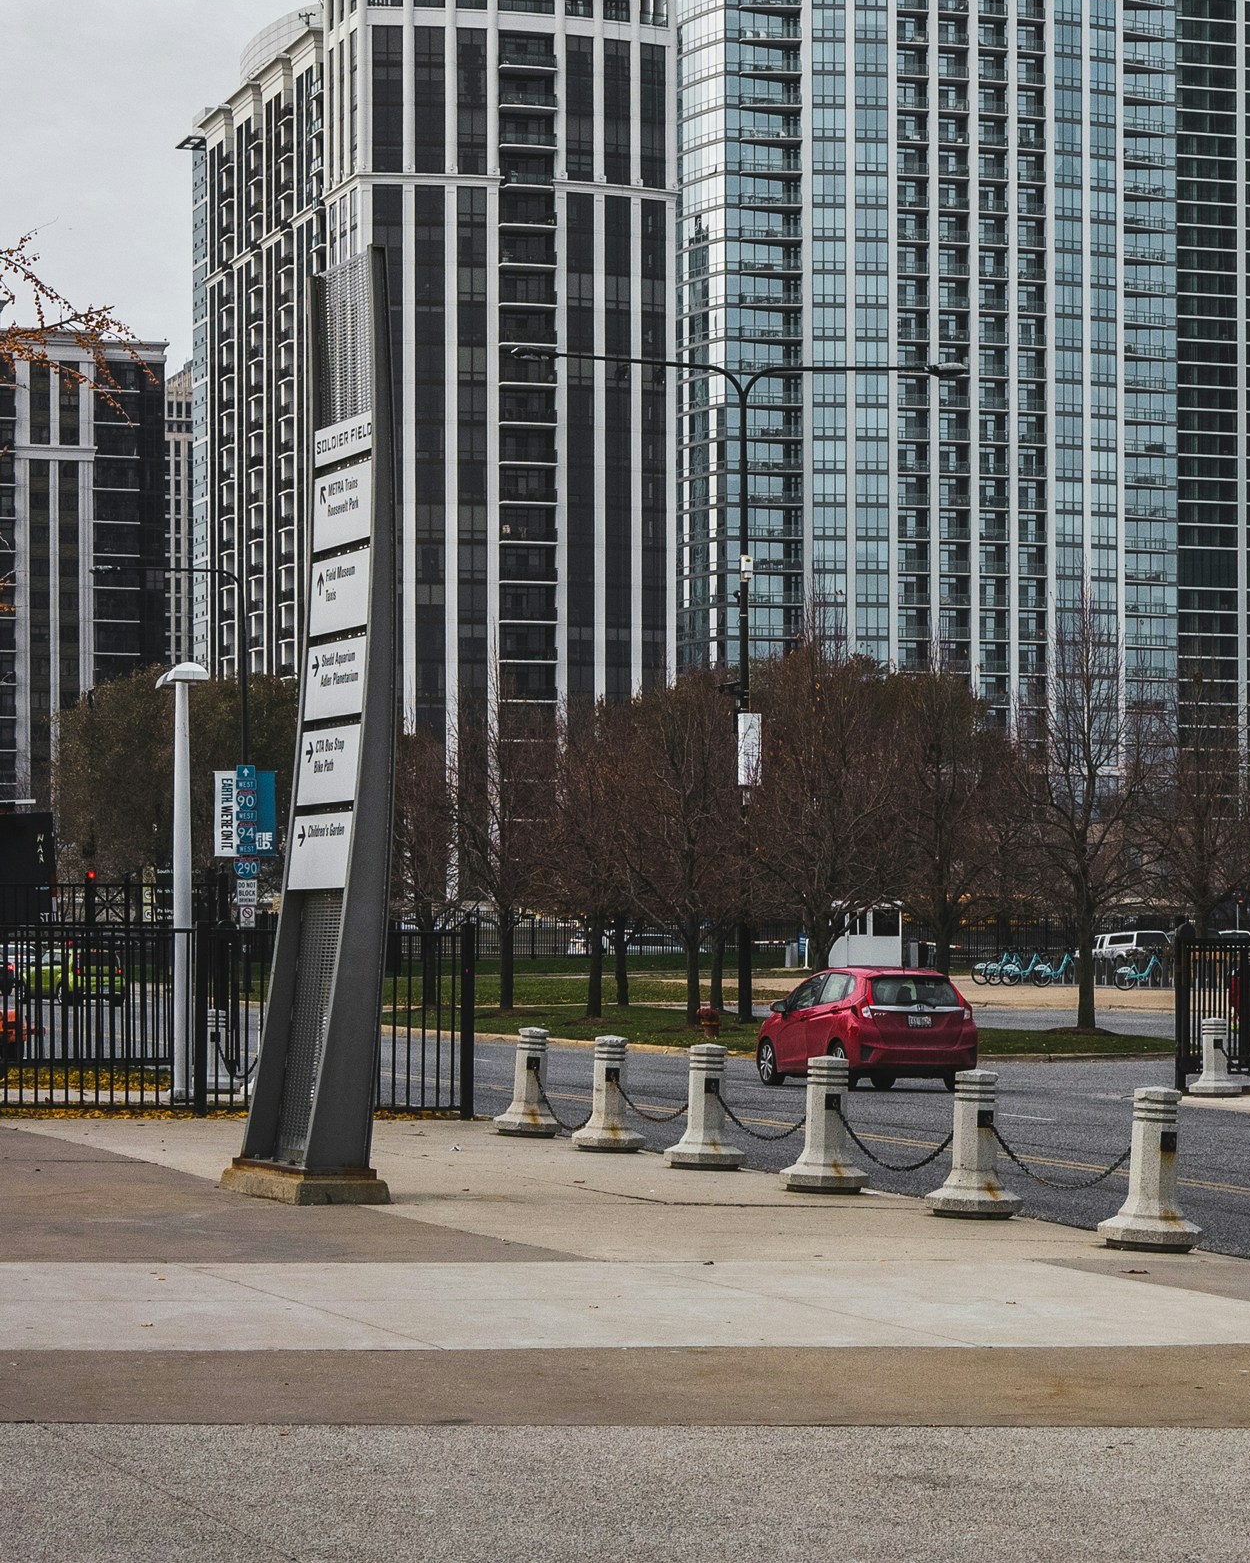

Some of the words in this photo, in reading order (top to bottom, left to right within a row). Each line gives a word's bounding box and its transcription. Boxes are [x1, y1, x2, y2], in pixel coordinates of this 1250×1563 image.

[316, 430, 349, 455] SOLDIER
[350, 422, 372, 442] FIELD
[328, 480, 344, 497] METRA
[345, 477, 358, 492] Trains
[327, 499, 348, 517] Roosevelt
[348, 496, 359, 511] Park
[325, 567, 336, 582] Field
[336, 565, 356, 579] Museum
[325, 588, 337, 602] Taxis
[321, 650, 335, 668] Shedd
[335, 649, 356, 666] Aquarium
[320, 674, 332, 688] Adler
[332, 669, 359, 686] Planetarium
[315, 739, 325, 754] CTA
[325, 739, 334, 753] Bus
[334, 737, 345, 753] Stop
[313, 760, 323, 774] Bike
[323, 759, 334, 772] Path
[237, 795, 254, 807] 90
[221, 830, 233, 841] ON
[237, 827, 255, 839] 94
[307, 823, 329, 838] Children's
[329, 822, 345, 837] Garden
[220, 841, 234, 851] IT.
[239, 845, 254, 853] WEST
[237, 862, 258, 875] 290
[238, 881, 246, 889] DO
[246, 881, 256, 889] NOT
